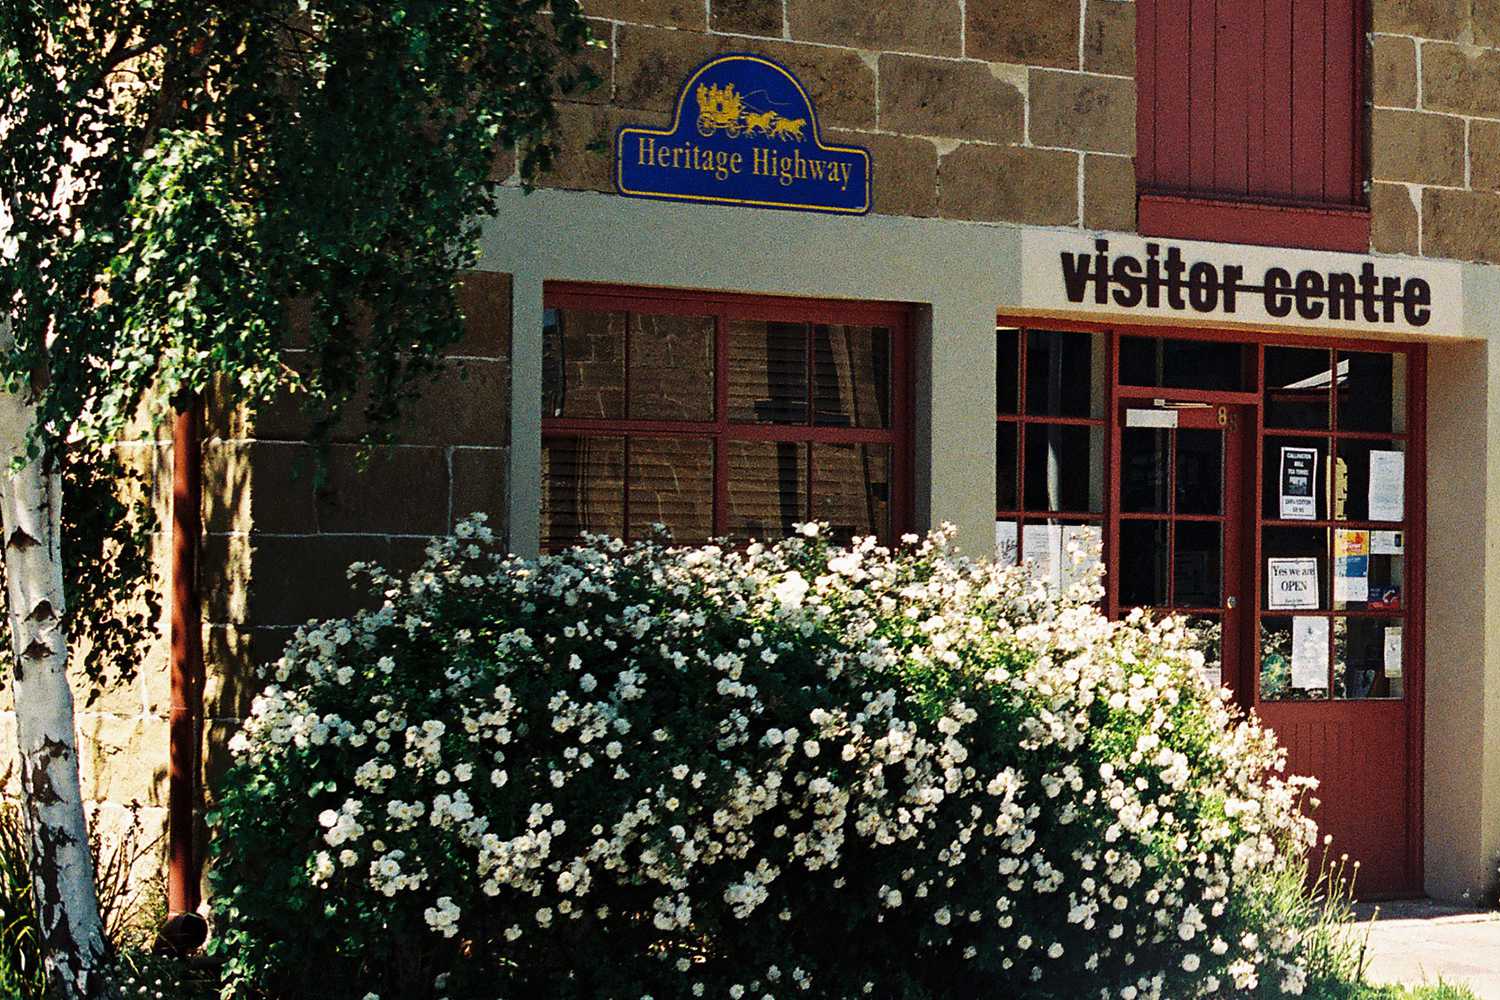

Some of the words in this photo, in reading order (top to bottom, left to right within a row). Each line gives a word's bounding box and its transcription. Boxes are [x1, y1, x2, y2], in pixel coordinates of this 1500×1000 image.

[637, 137, 743, 181] Heritage
[752, 147, 852, 192] Highway
[1060, 239, 1243, 314] visitor
[1263, 262, 1431, 327] centre
[1272, 565, 1288, 577] Yes
[1281, 580, 1308, 592] OPEN
